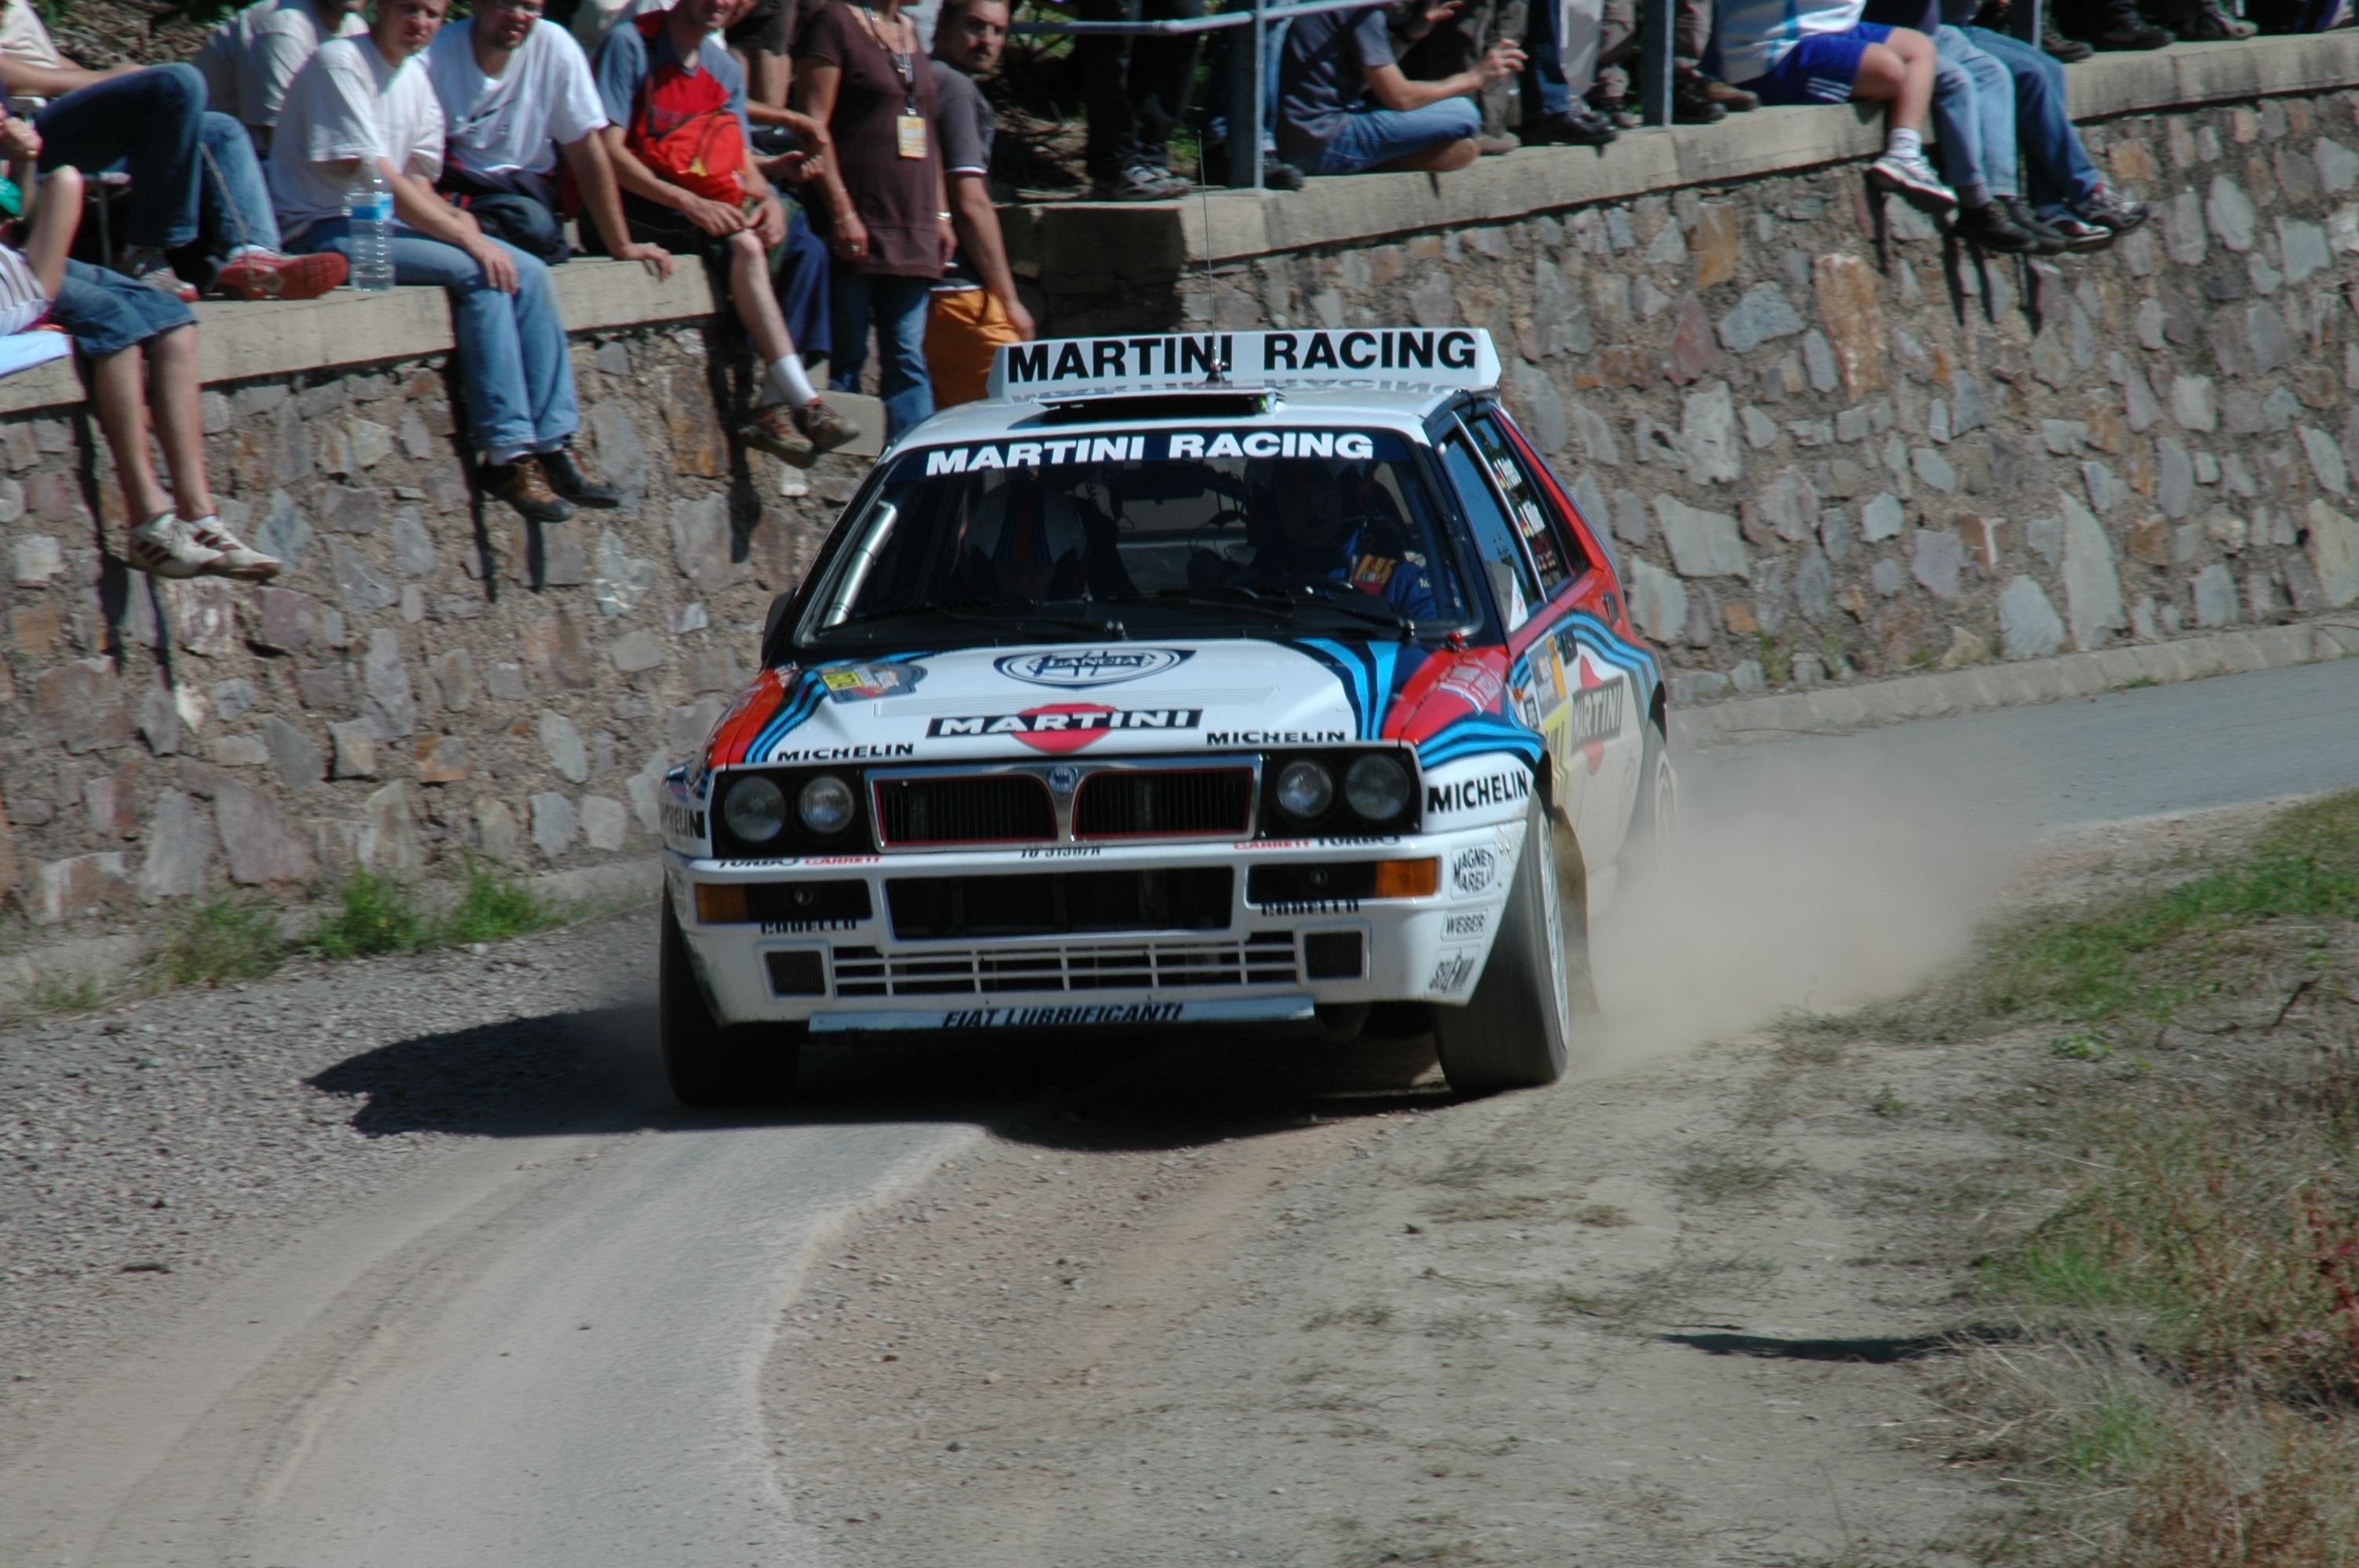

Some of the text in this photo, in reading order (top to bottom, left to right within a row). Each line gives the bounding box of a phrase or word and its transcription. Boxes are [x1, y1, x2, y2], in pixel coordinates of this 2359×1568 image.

[1007, 331, 1477, 383] MARTINI RACING
[926, 433, 1374, 476] MARTINI RACING
[940, 710, 1190, 736] MARTINI
[1207, 730, 1347, 745] MICHELIN
[776, 743, 914, 761] MICHELIN
[1427, 770, 1529, 814] MICHELIN
[1446, 913, 1485, 935] WEBER
[942, 1002, 1184, 1029] FIAT LUBRIFICANTI
